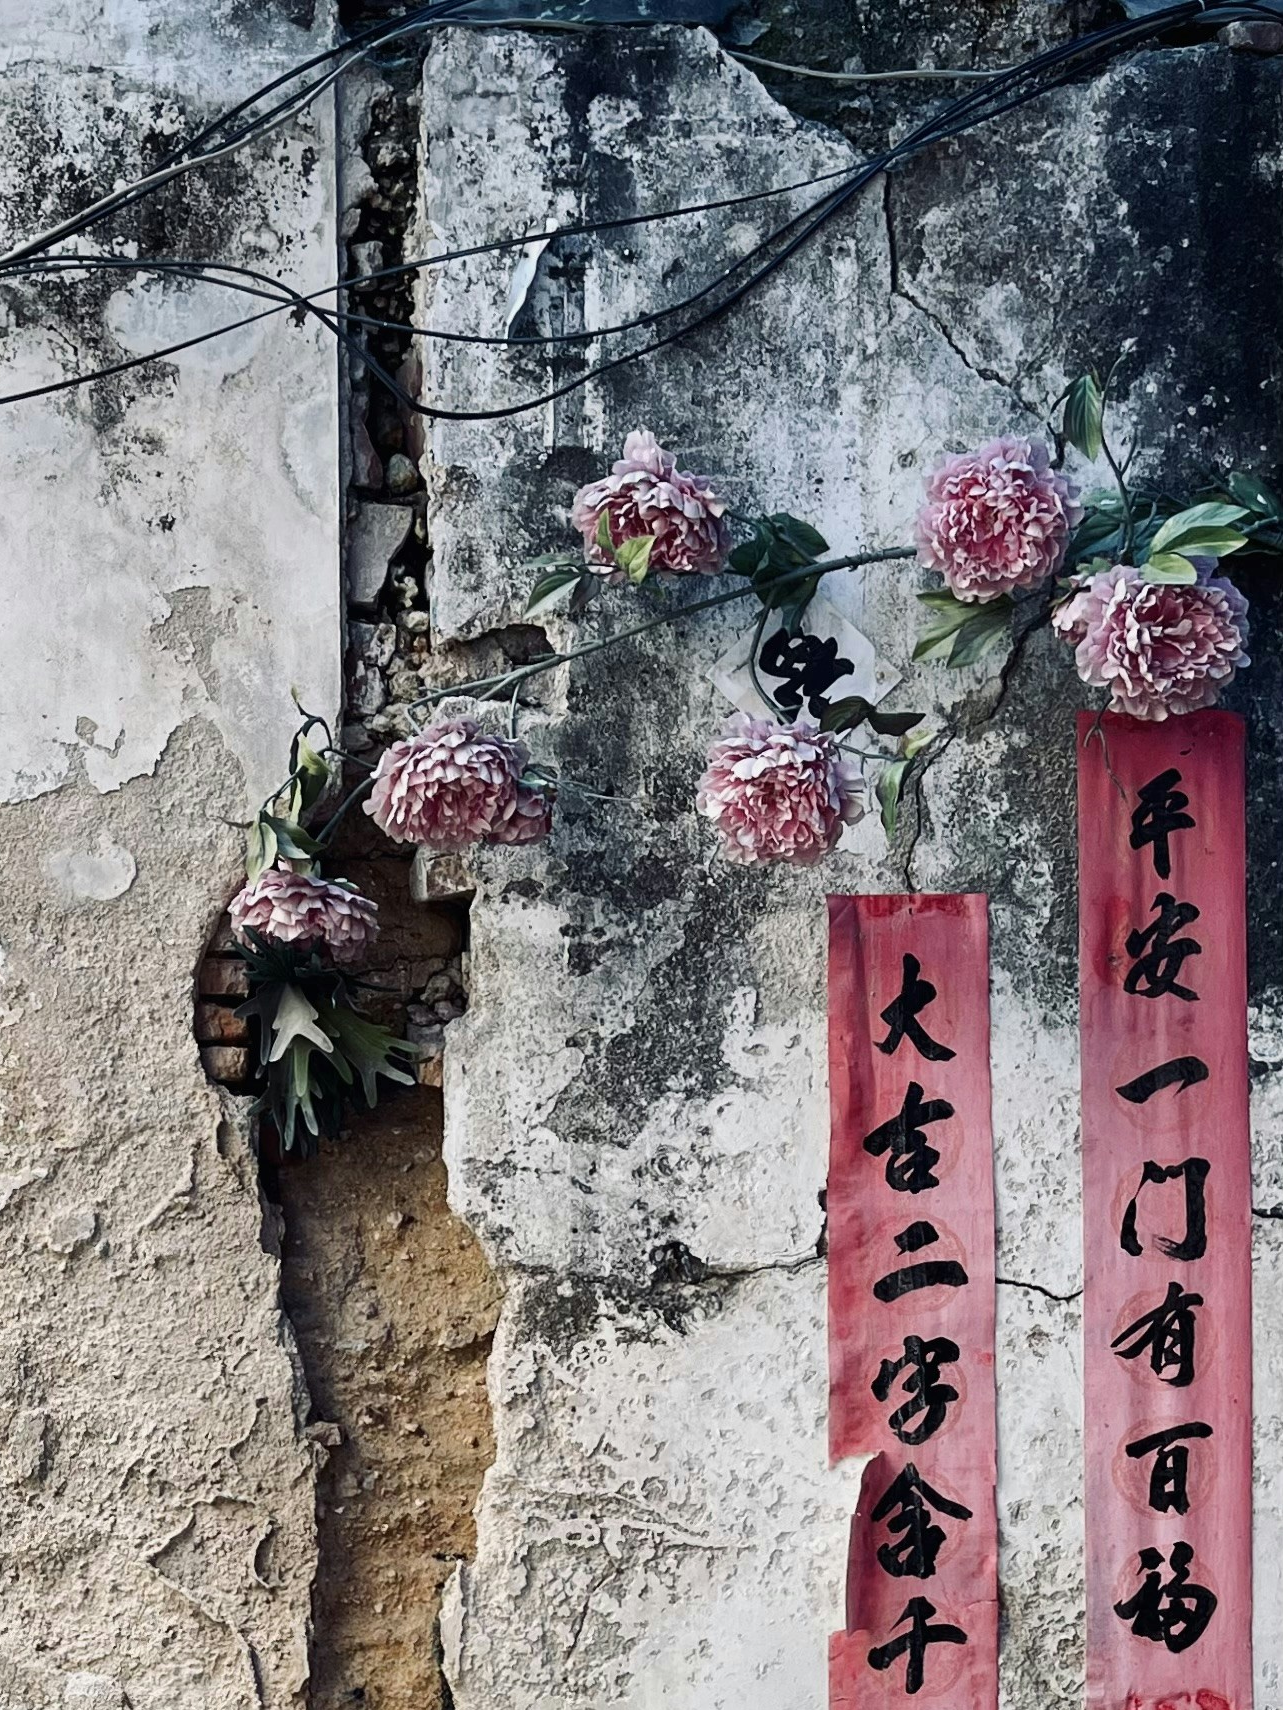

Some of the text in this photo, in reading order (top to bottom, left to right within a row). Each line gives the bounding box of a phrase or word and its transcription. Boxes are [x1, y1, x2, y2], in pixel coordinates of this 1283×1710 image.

[1111, 768, 1217, 1653] 平安一门有百福
